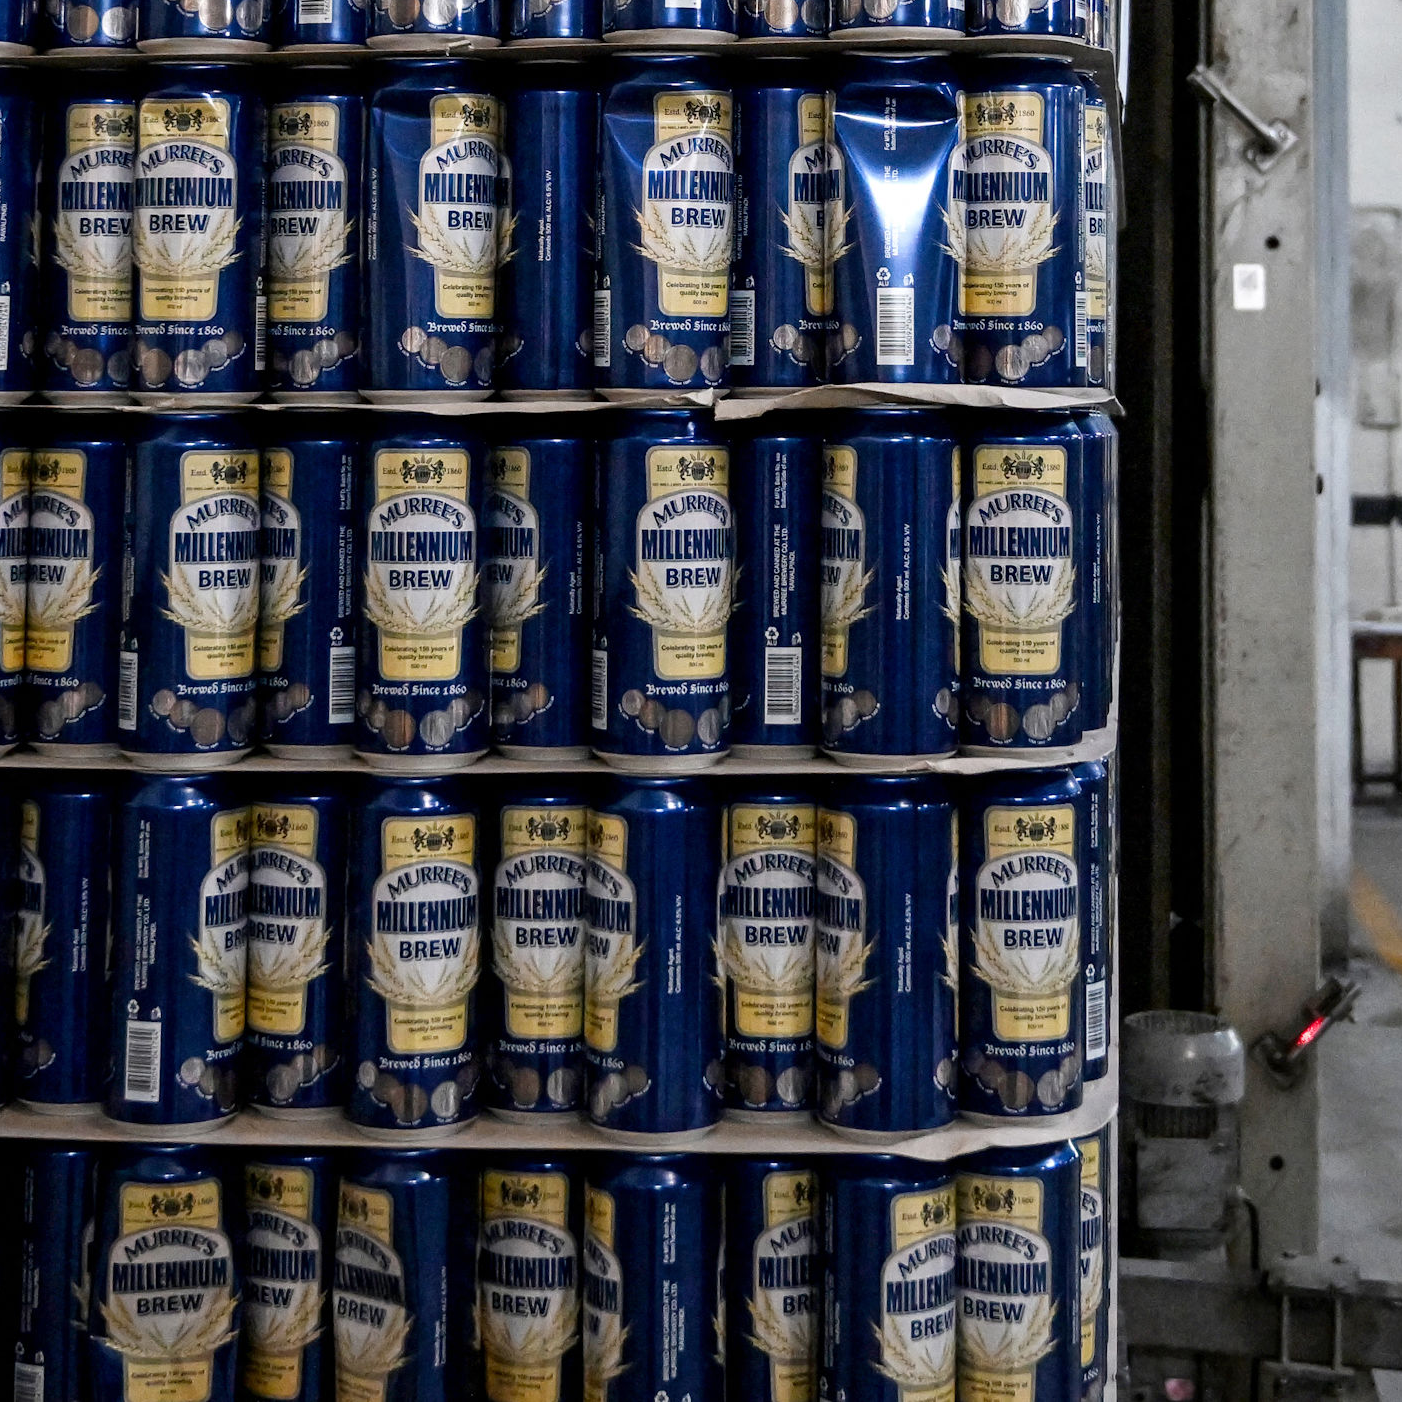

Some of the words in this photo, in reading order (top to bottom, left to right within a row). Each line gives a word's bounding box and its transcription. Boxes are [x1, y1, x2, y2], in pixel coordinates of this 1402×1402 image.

[140, 143, 225, 175] MURREE'S
[149, 213, 210, 234] BREW
[671, 207, 726, 230] BREW
[164, 323, 194, 335] Since
[196, 324, 224, 336] 1860
[651, 320, 691, 333] Brewed
[693, 320, 718, 332] Since
[379, 498, 466, 531] MURREE'S
[652, 494, 729, 528] MURREE'S
[978, 494, 1062, 527] MURREE'S
[371, 529, 472, 561] MILLENNIUM
[969, 526, 1069, 557] MILLENNIUM
[389, 569, 453, 590] BREW
[666, 566, 721, 588] BREW
[990, 564, 1053, 586] BREW
[372, 683, 409, 696] Brewed
[412, 683, 441, 695] Since
[444, 683, 468, 695] 1860
[646, 682, 686, 695] Brewed
[690, 682, 713, 694] Since
[972, 677, 1012, 690] Brewed
[1015, 677, 1043, 689] Since
[1045, 678, 1066, 689] 1860
[991, 853, 1073, 887] MURREE'S
[387, 865, 472, 899] MURREE'S
[377, 895, 477, 933] MILLENNIUM
[981, 886, 1076, 921] MILLENNIUM
[399, 937, 461, 960] BREW
[1003, 928, 1064, 950] BREW
[986, 1042, 1024, 1057] Brewed
[1027, 1043, 1054, 1056] Since
[1057, 1043, 1075, 1054] 1860
[379, 1055, 420, 1071] Brewed
[423, 1055, 450, 1068] Since
[452, 1052, 472, 1066] 1860
[124, 1233, 217, 1262] MURREE'S
[113, 1261, 227, 1293] MILLENNIUM
[137, 1293, 204, 1314] BREW
[963, 1297, 1025, 1322] BREW
